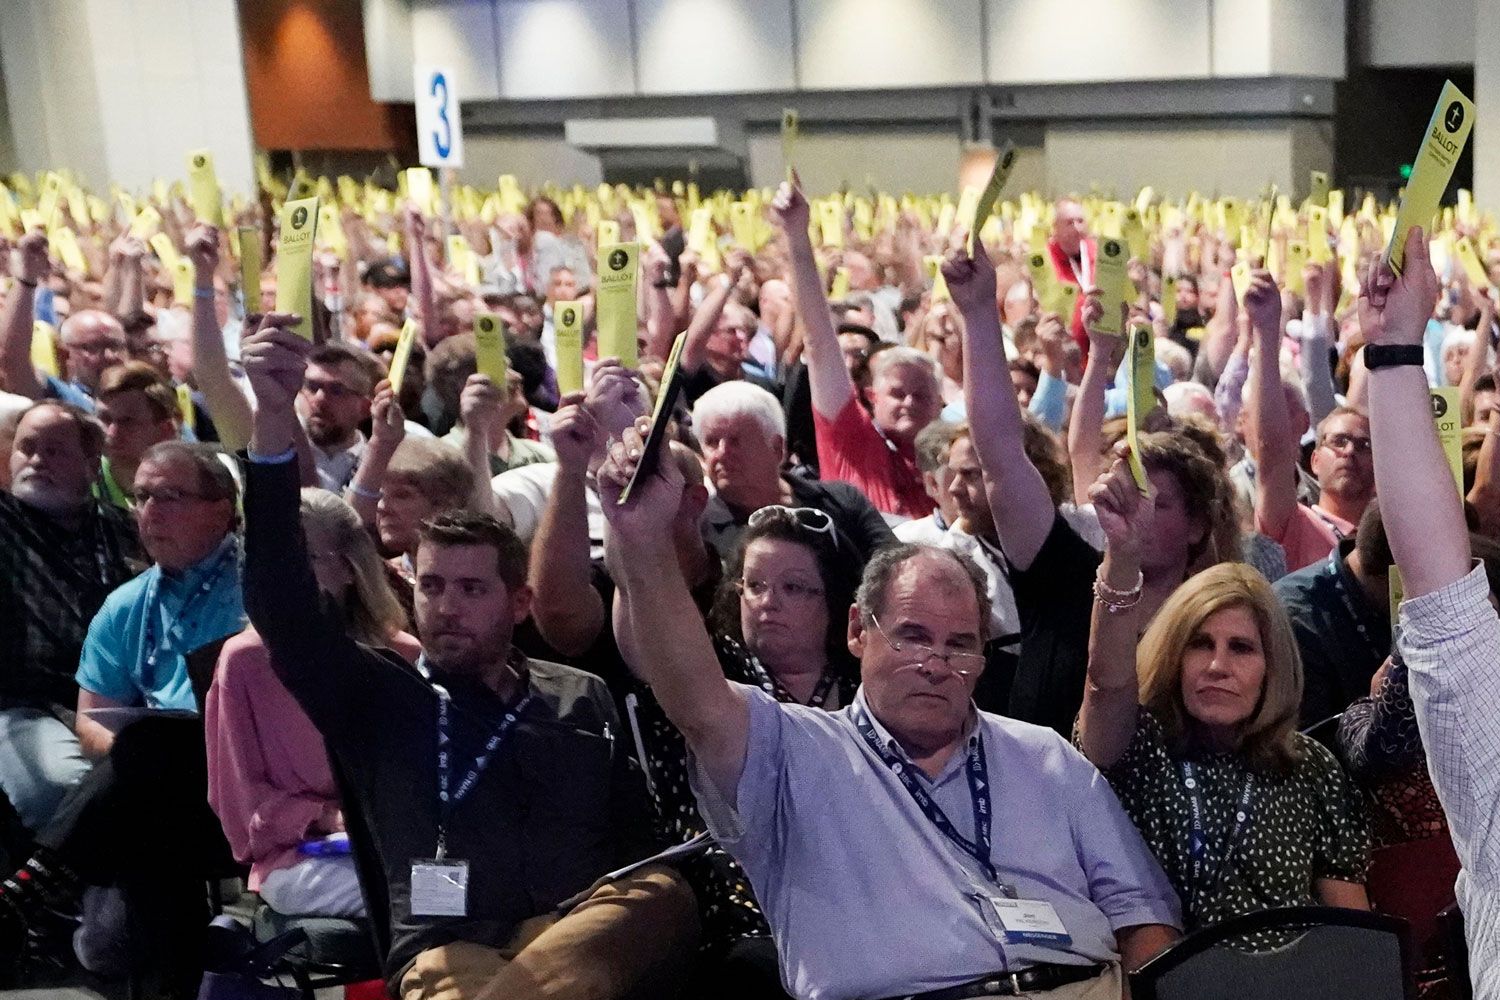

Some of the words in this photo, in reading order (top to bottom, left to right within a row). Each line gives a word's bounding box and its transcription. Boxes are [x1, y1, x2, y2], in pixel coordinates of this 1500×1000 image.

[431, 72, 452, 159] 3
[1431, 126, 1458, 155] BALLOT
[283, 231, 311, 245] BALLOT
[601, 272, 633, 283] BALLOT
[1183, 761, 1192, 777] SBC
[914, 790, 929, 808] imb
[978, 797, 987, 815] imb
